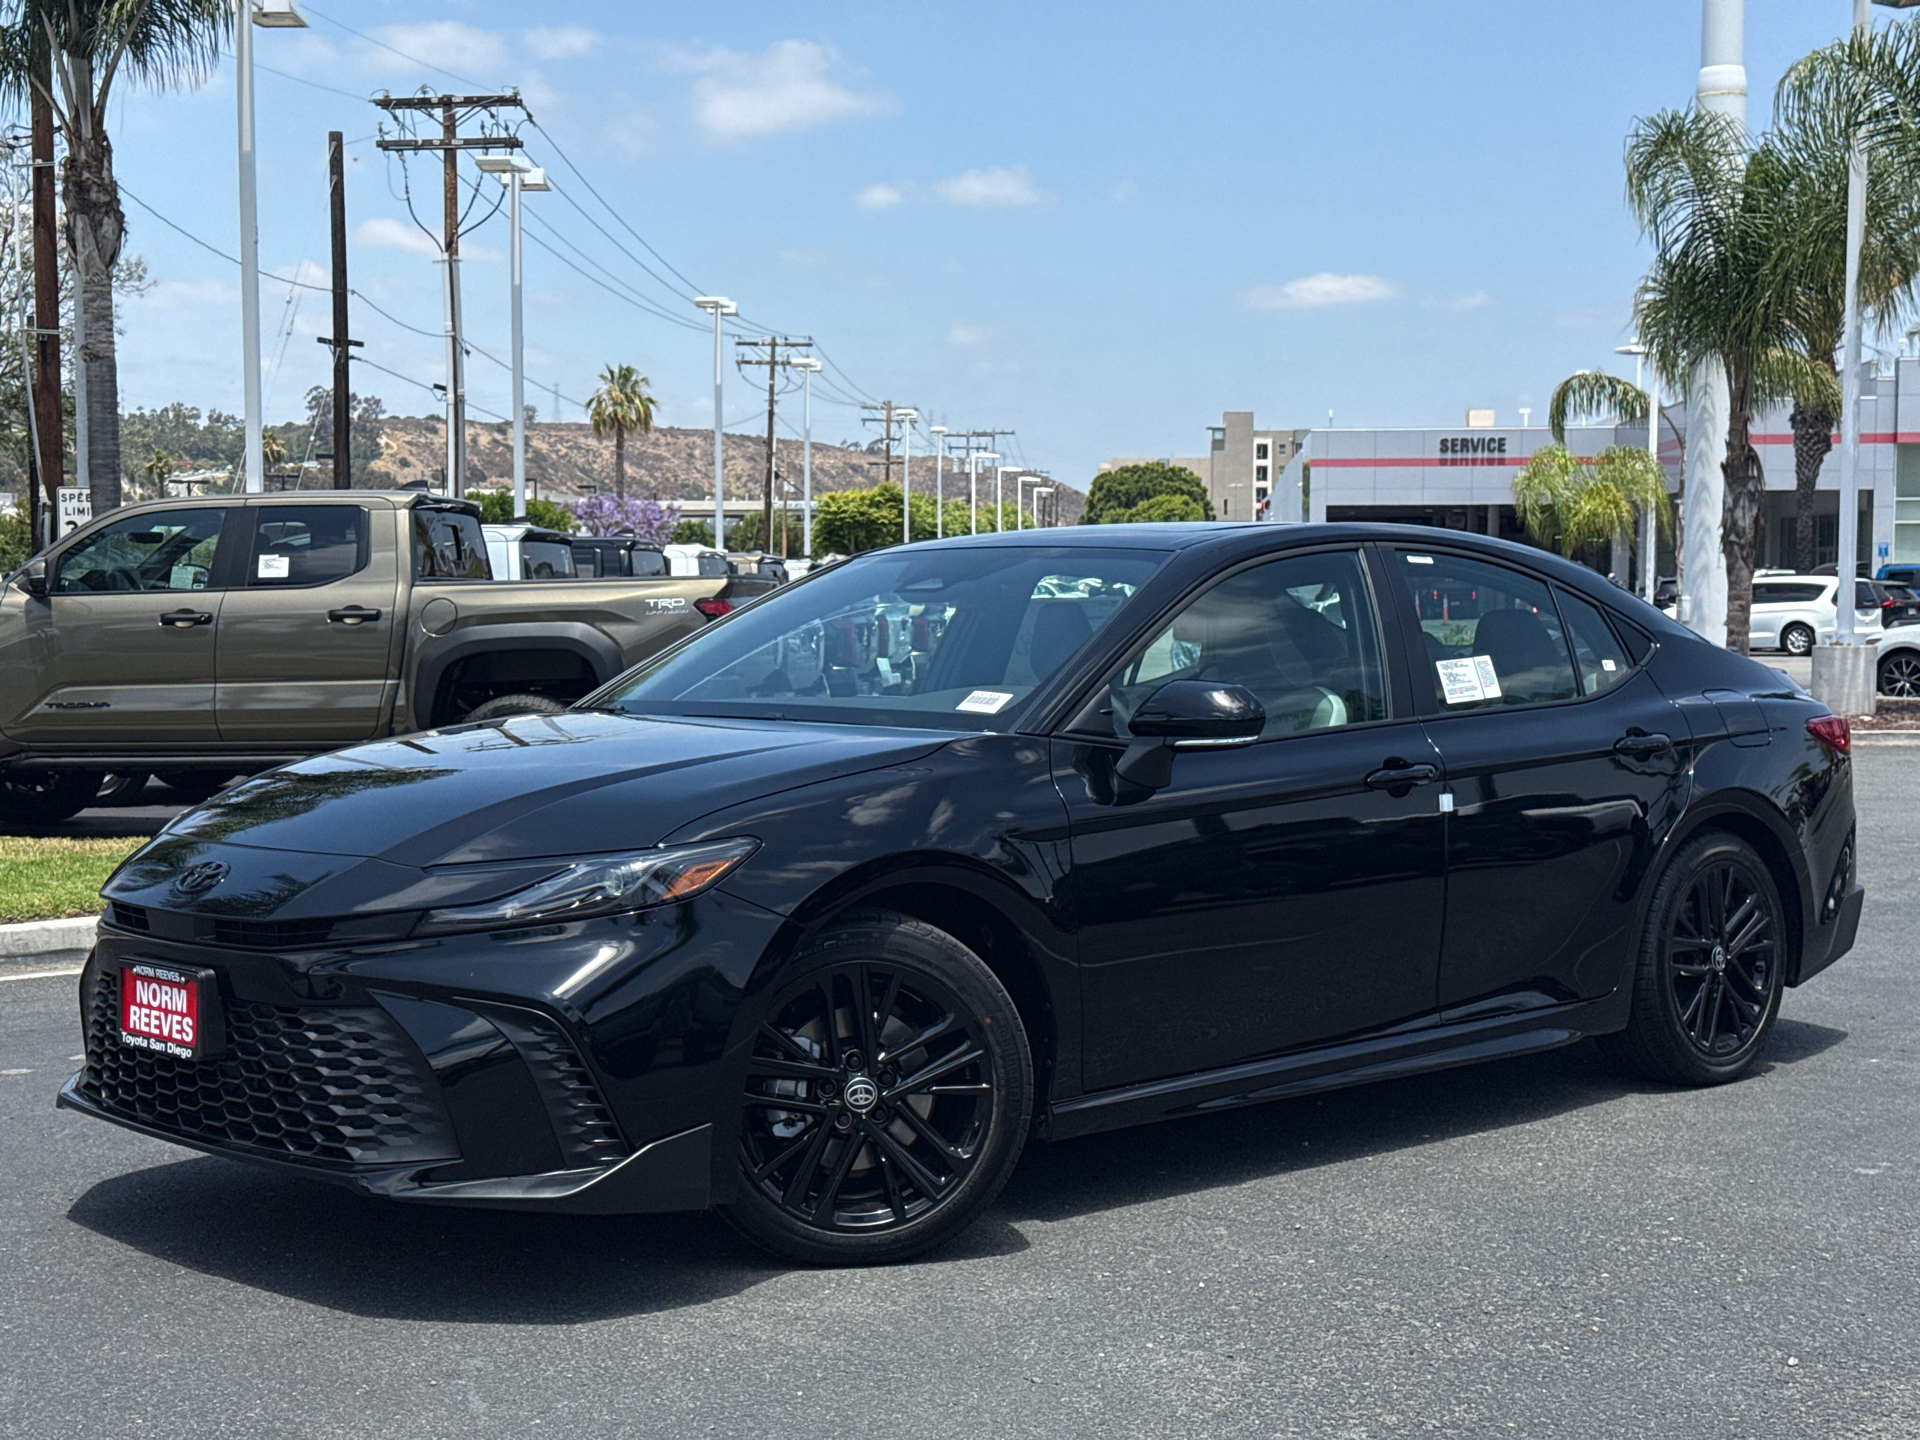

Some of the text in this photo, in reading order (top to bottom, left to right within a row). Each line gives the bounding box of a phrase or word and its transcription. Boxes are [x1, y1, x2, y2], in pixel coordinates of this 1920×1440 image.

[1439, 436, 1507, 454] SERVICE
[60, 492, 92, 503] SPEE
[64, 506, 91, 517] LIMI
[644, 597, 686, 610] TRD
[135, 964, 180, 983] NORM REEVES
[129, 979, 194, 1043] NORM REEVES
[120, 1031, 193, 1060] Toyota San Diego
